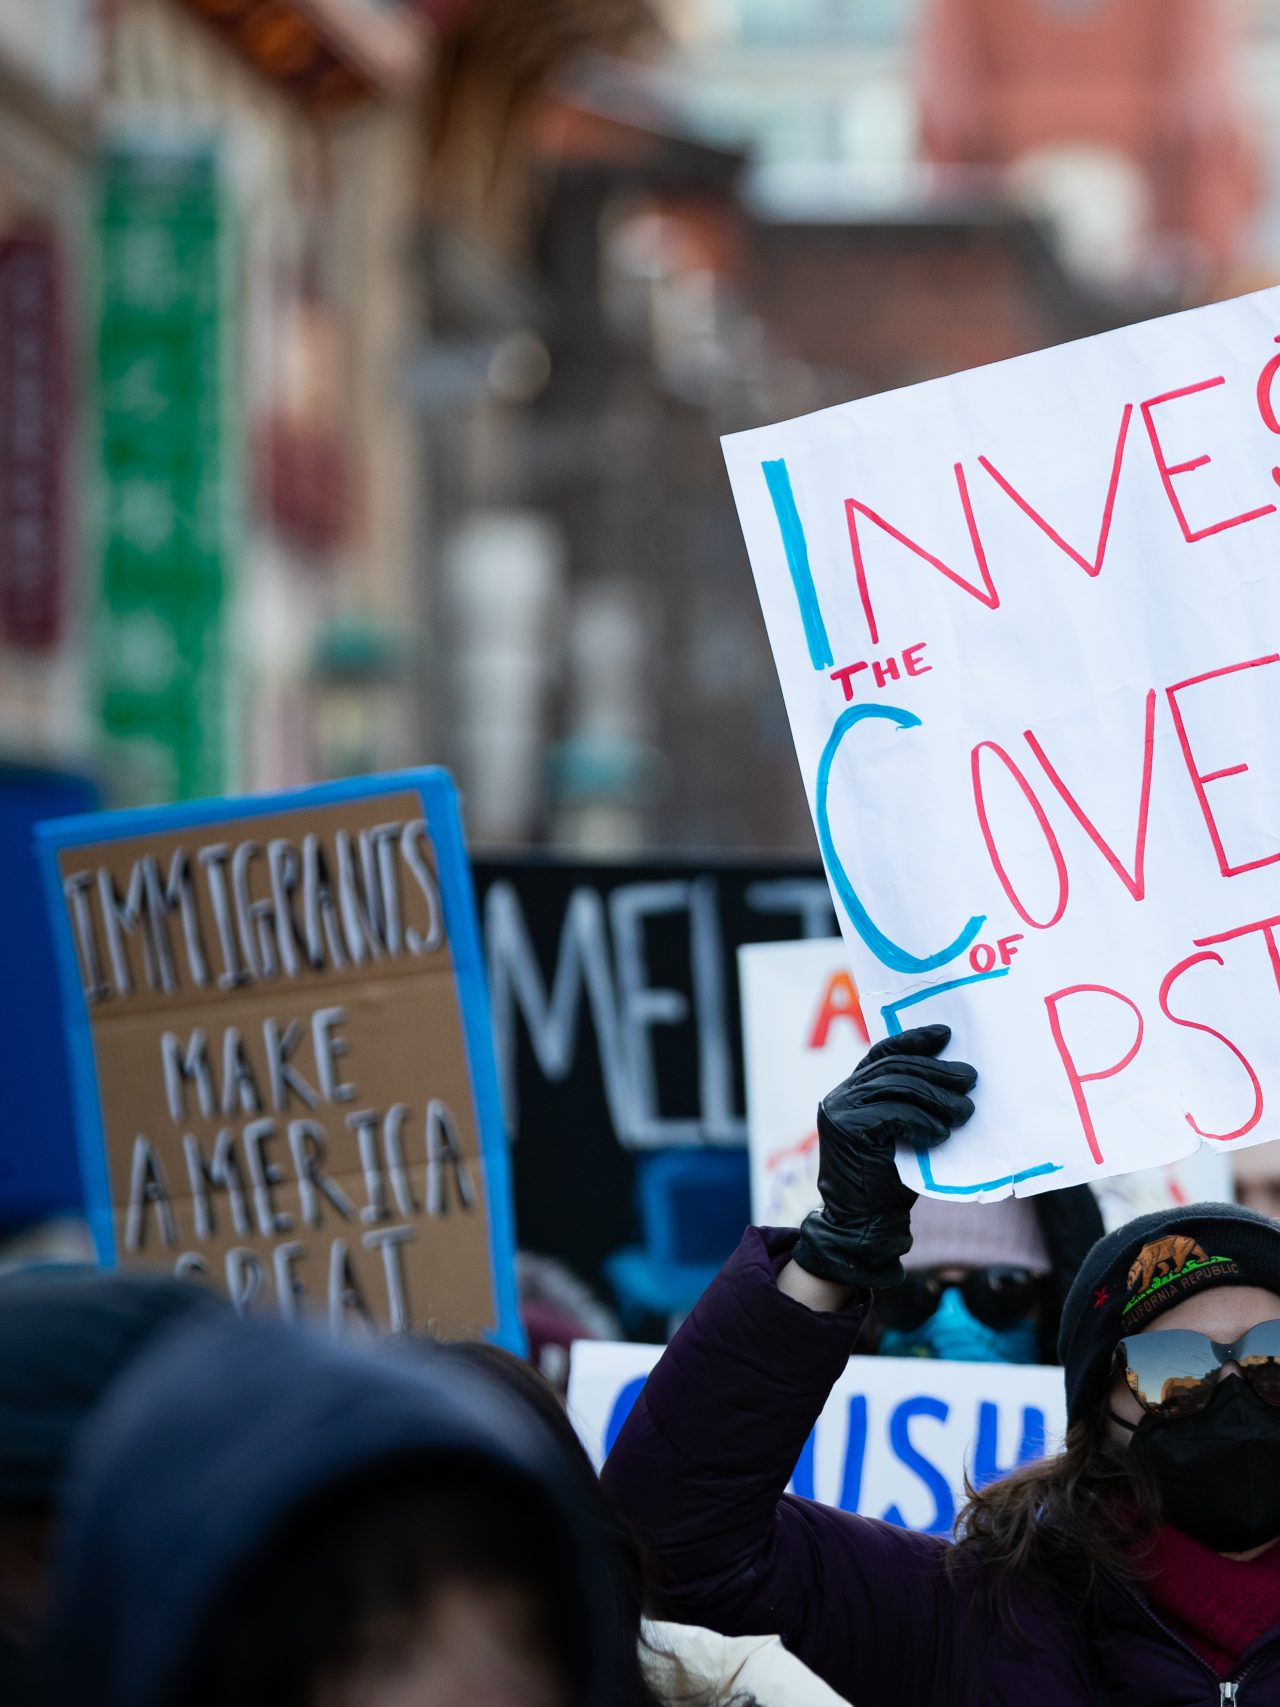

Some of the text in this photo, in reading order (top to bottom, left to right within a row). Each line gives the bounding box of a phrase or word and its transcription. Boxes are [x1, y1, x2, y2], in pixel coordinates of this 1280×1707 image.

[830, 642, 933, 701] THE
[64, 818, 446, 998] IMMIGRANTS
[969, 934, 1024, 974] OF
[161, 1005, 357, 1125] MAKE
[125, 1098, 475, 1253] AMERICA
[174, 1224, 416, 1340] REAT
[1181, 1263, 1240, 1289] REPUBLIC
